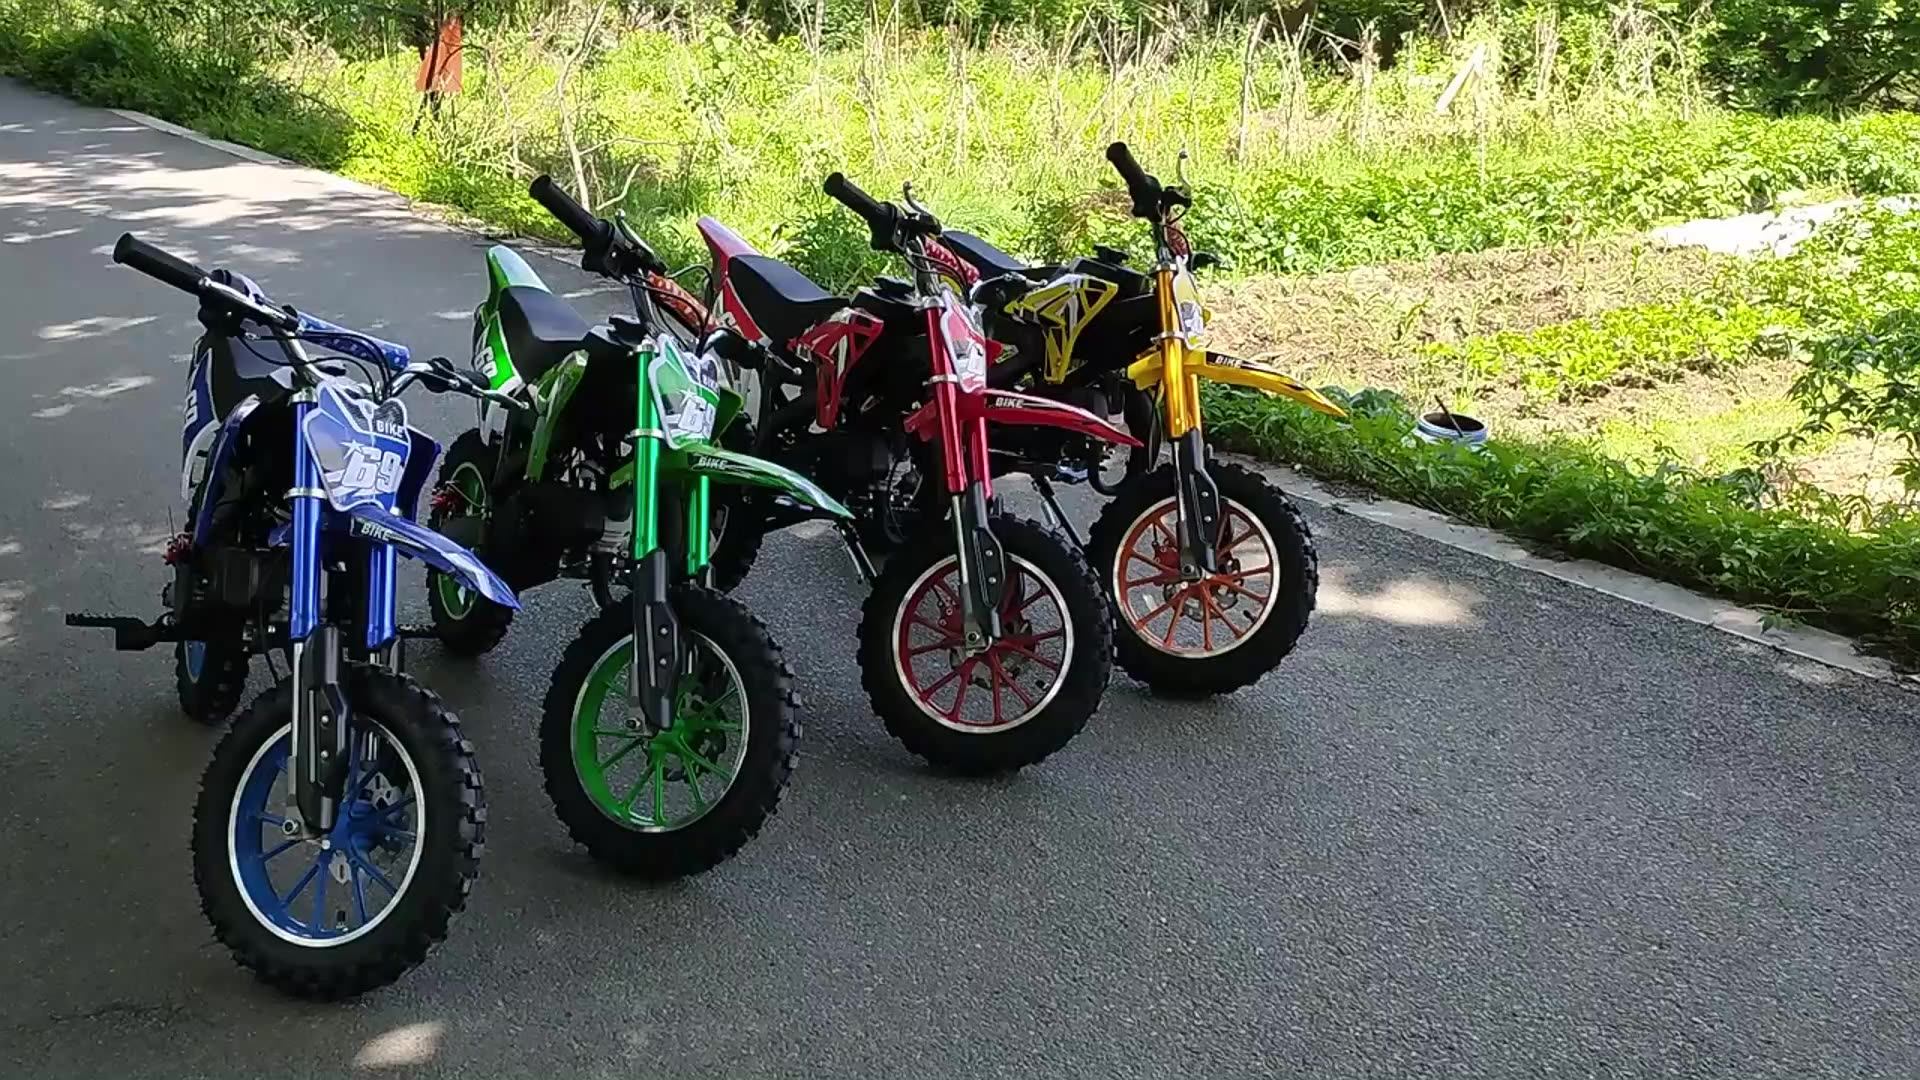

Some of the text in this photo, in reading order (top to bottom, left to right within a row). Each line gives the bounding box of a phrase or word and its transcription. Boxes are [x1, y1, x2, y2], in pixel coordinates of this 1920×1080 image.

[1215, 354, 1242, 368] BIKE
[995, 397, 1023, 409] BIKE
[376, 420, 404, 438] BIKE
[341, 446, 401, 494] 69
[699, 456, 728, 471] BIKE
[361, 522, 392, 542] BIKE
